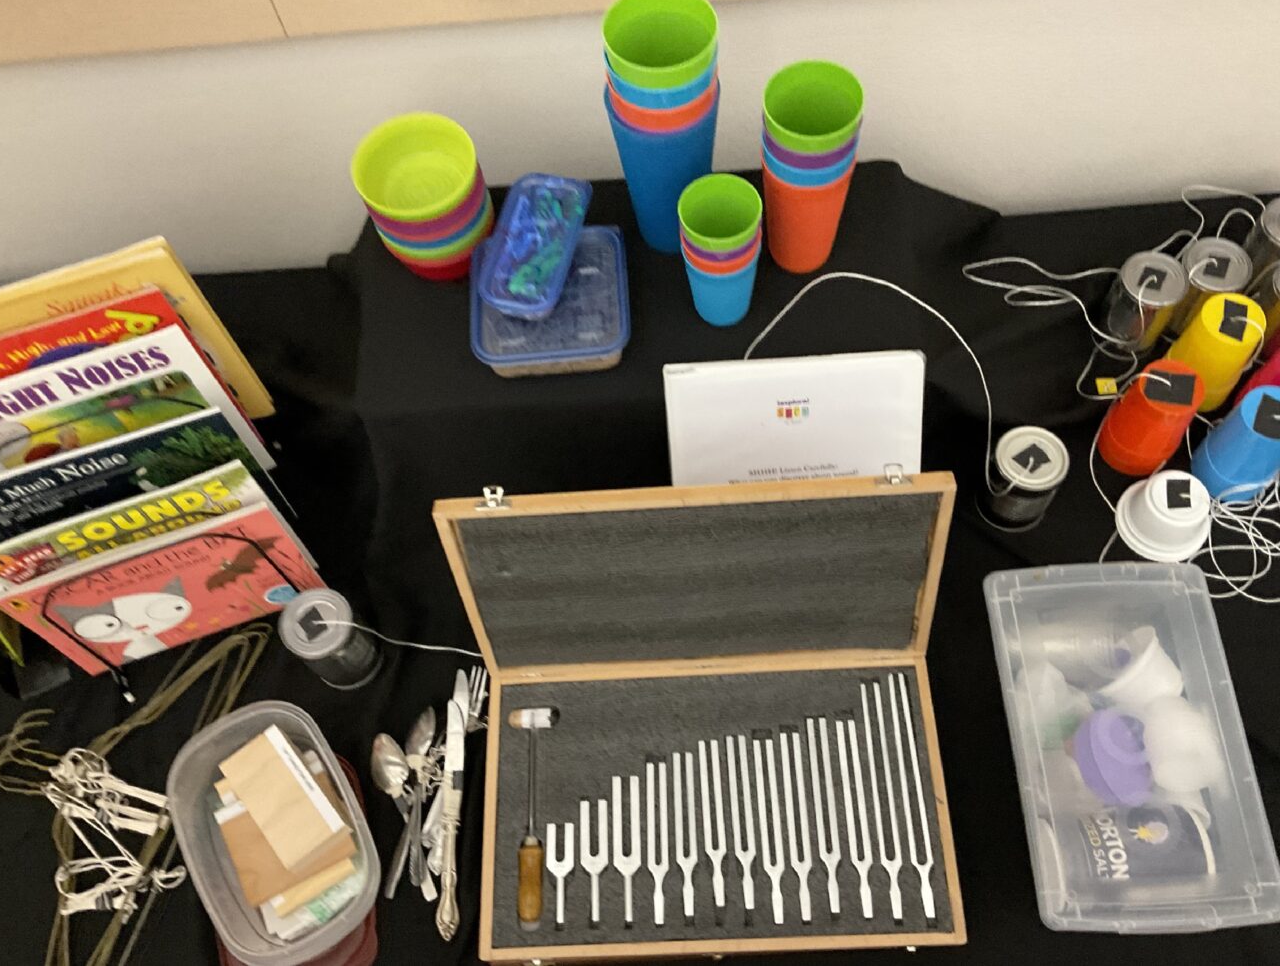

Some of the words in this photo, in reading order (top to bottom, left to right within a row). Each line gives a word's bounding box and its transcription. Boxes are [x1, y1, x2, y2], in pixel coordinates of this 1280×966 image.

[6, 340, 54, 364] High,
[55, 345, 171, 395] NOISES
[3, 477, 57, 501] Much
[56, 451, 129, 483] Noise
[56, 479, 230, 552] SOUNDS
[124, 554, 163, 577] and
[162, 544, 201, 565] the
[1092, 848, 1110, 879] SAL
[1096, 816, 1130, 880] ORTON
